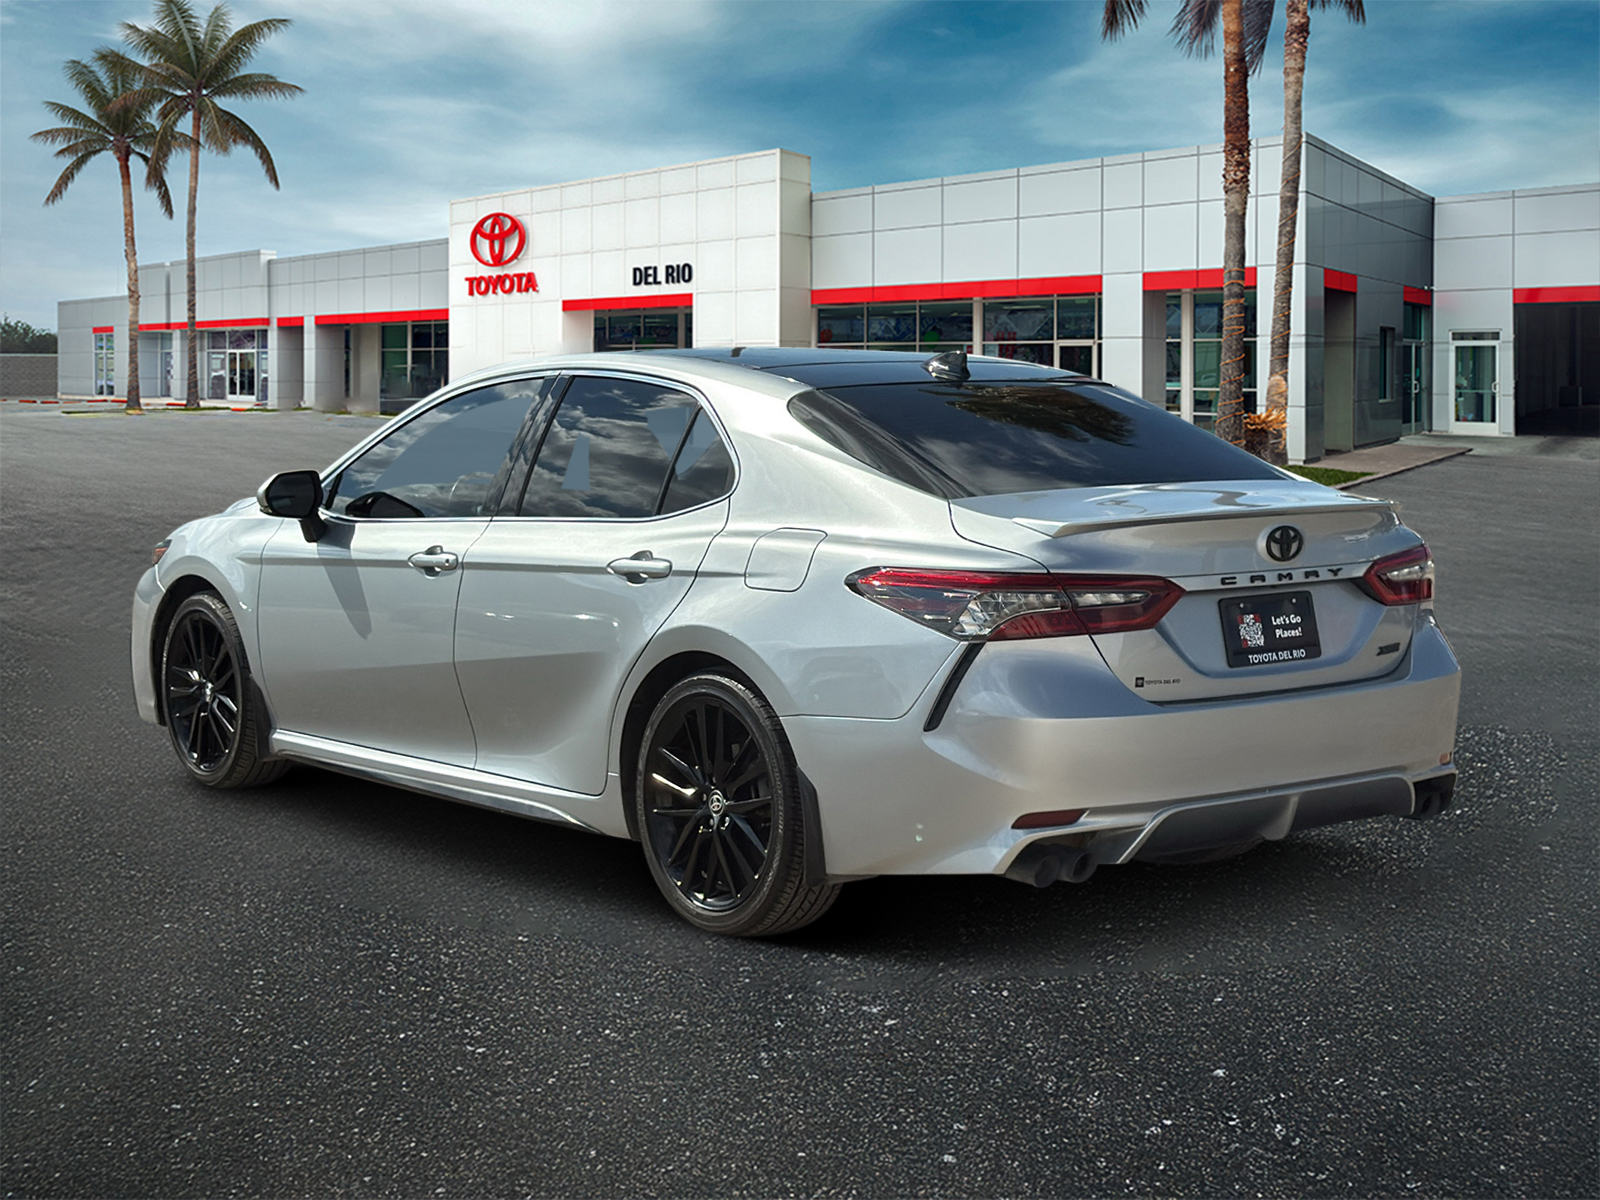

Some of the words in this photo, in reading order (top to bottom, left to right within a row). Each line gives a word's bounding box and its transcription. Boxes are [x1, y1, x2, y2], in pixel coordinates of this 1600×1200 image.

[632, 266, 661, 286] DEL
[665, 263, 693, 284] RIO
[465, 272, 538, 296] TOYOTA
[1220, 567, 1343, 586] CAMRY
[1271, 615, 1289, 625] Let's
[1289, 614, 1302, 624] Go
[1275, 627, 1302, 639] Places!
[1248, 652, 1278, 664] TOYOTA
[1278, 650, 1292, 660] DEL
[1293, 648, 1306, 658] RIO
